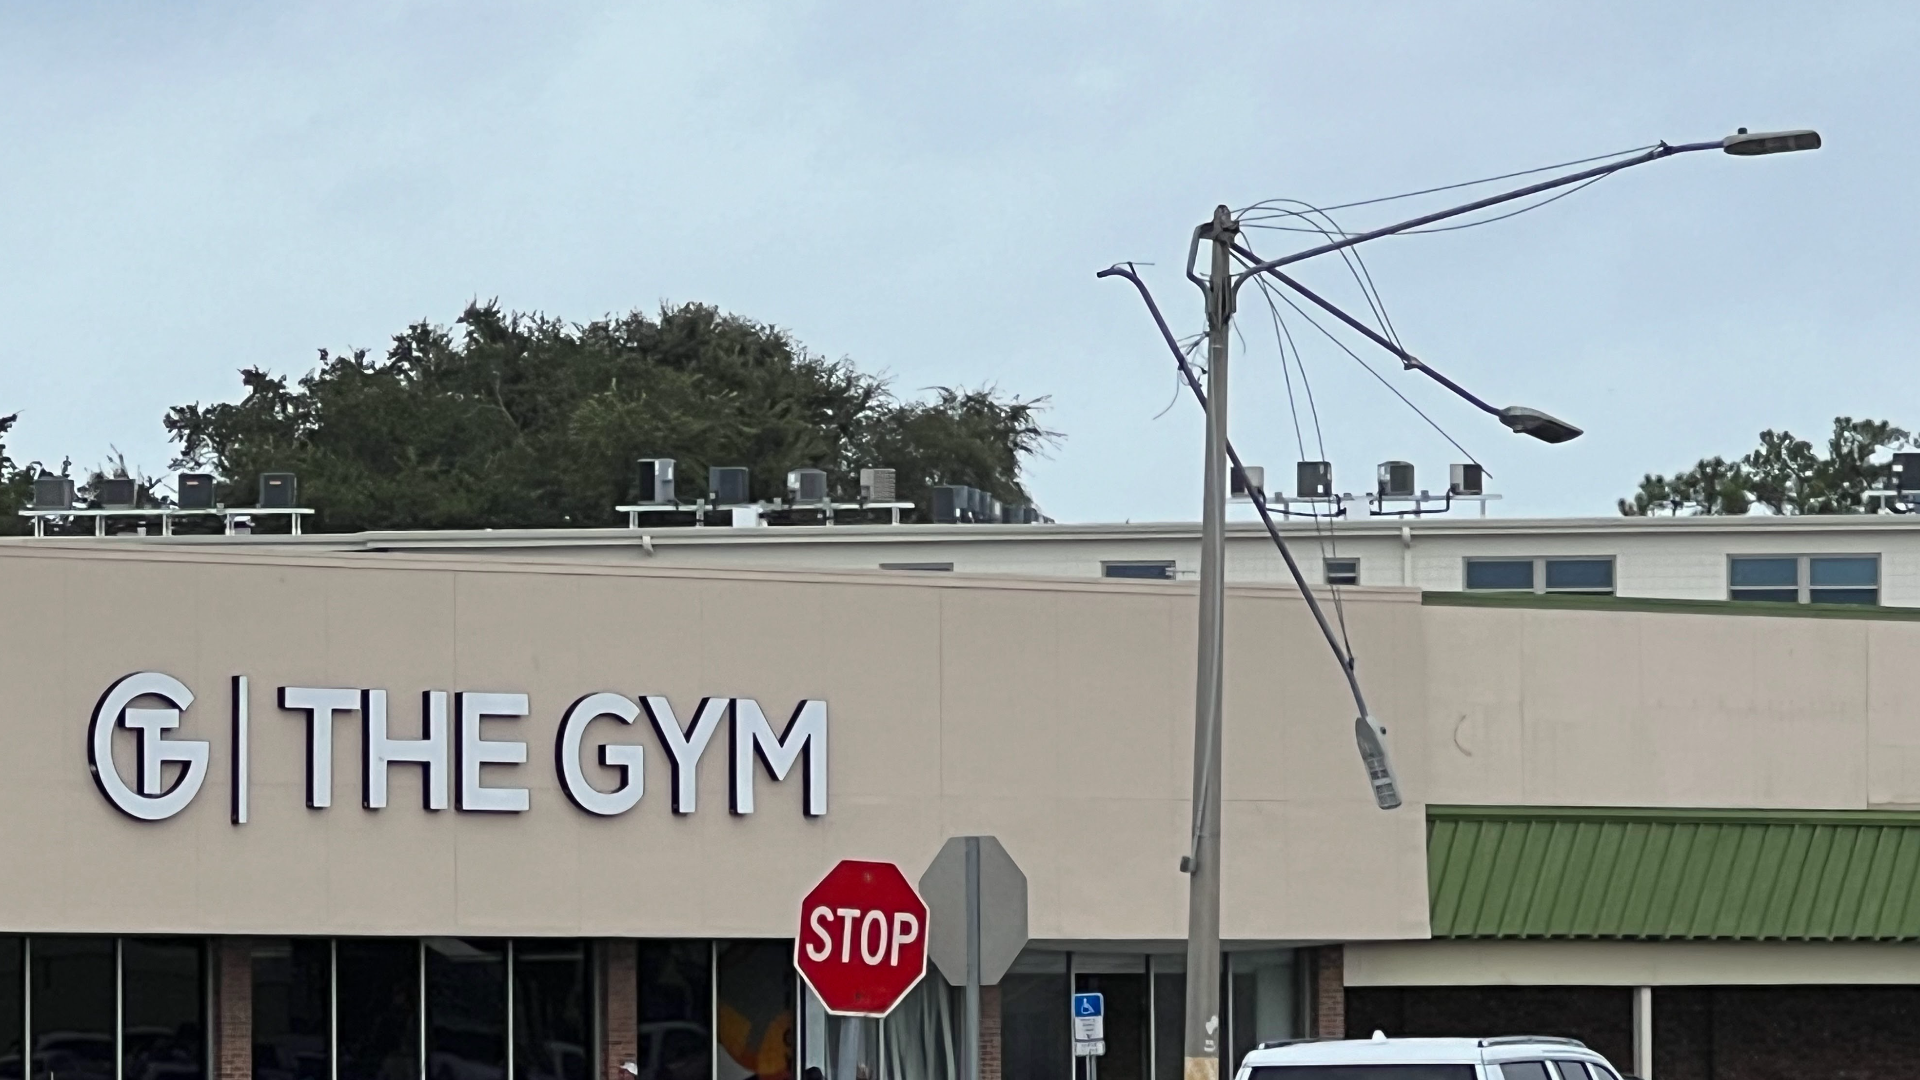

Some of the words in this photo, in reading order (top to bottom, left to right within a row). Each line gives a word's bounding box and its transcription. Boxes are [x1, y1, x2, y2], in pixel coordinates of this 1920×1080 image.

[278, 686, 530, 812] THE
[555, 692, 828, 816] GYM
[806, 906, 919, 967] STOP
